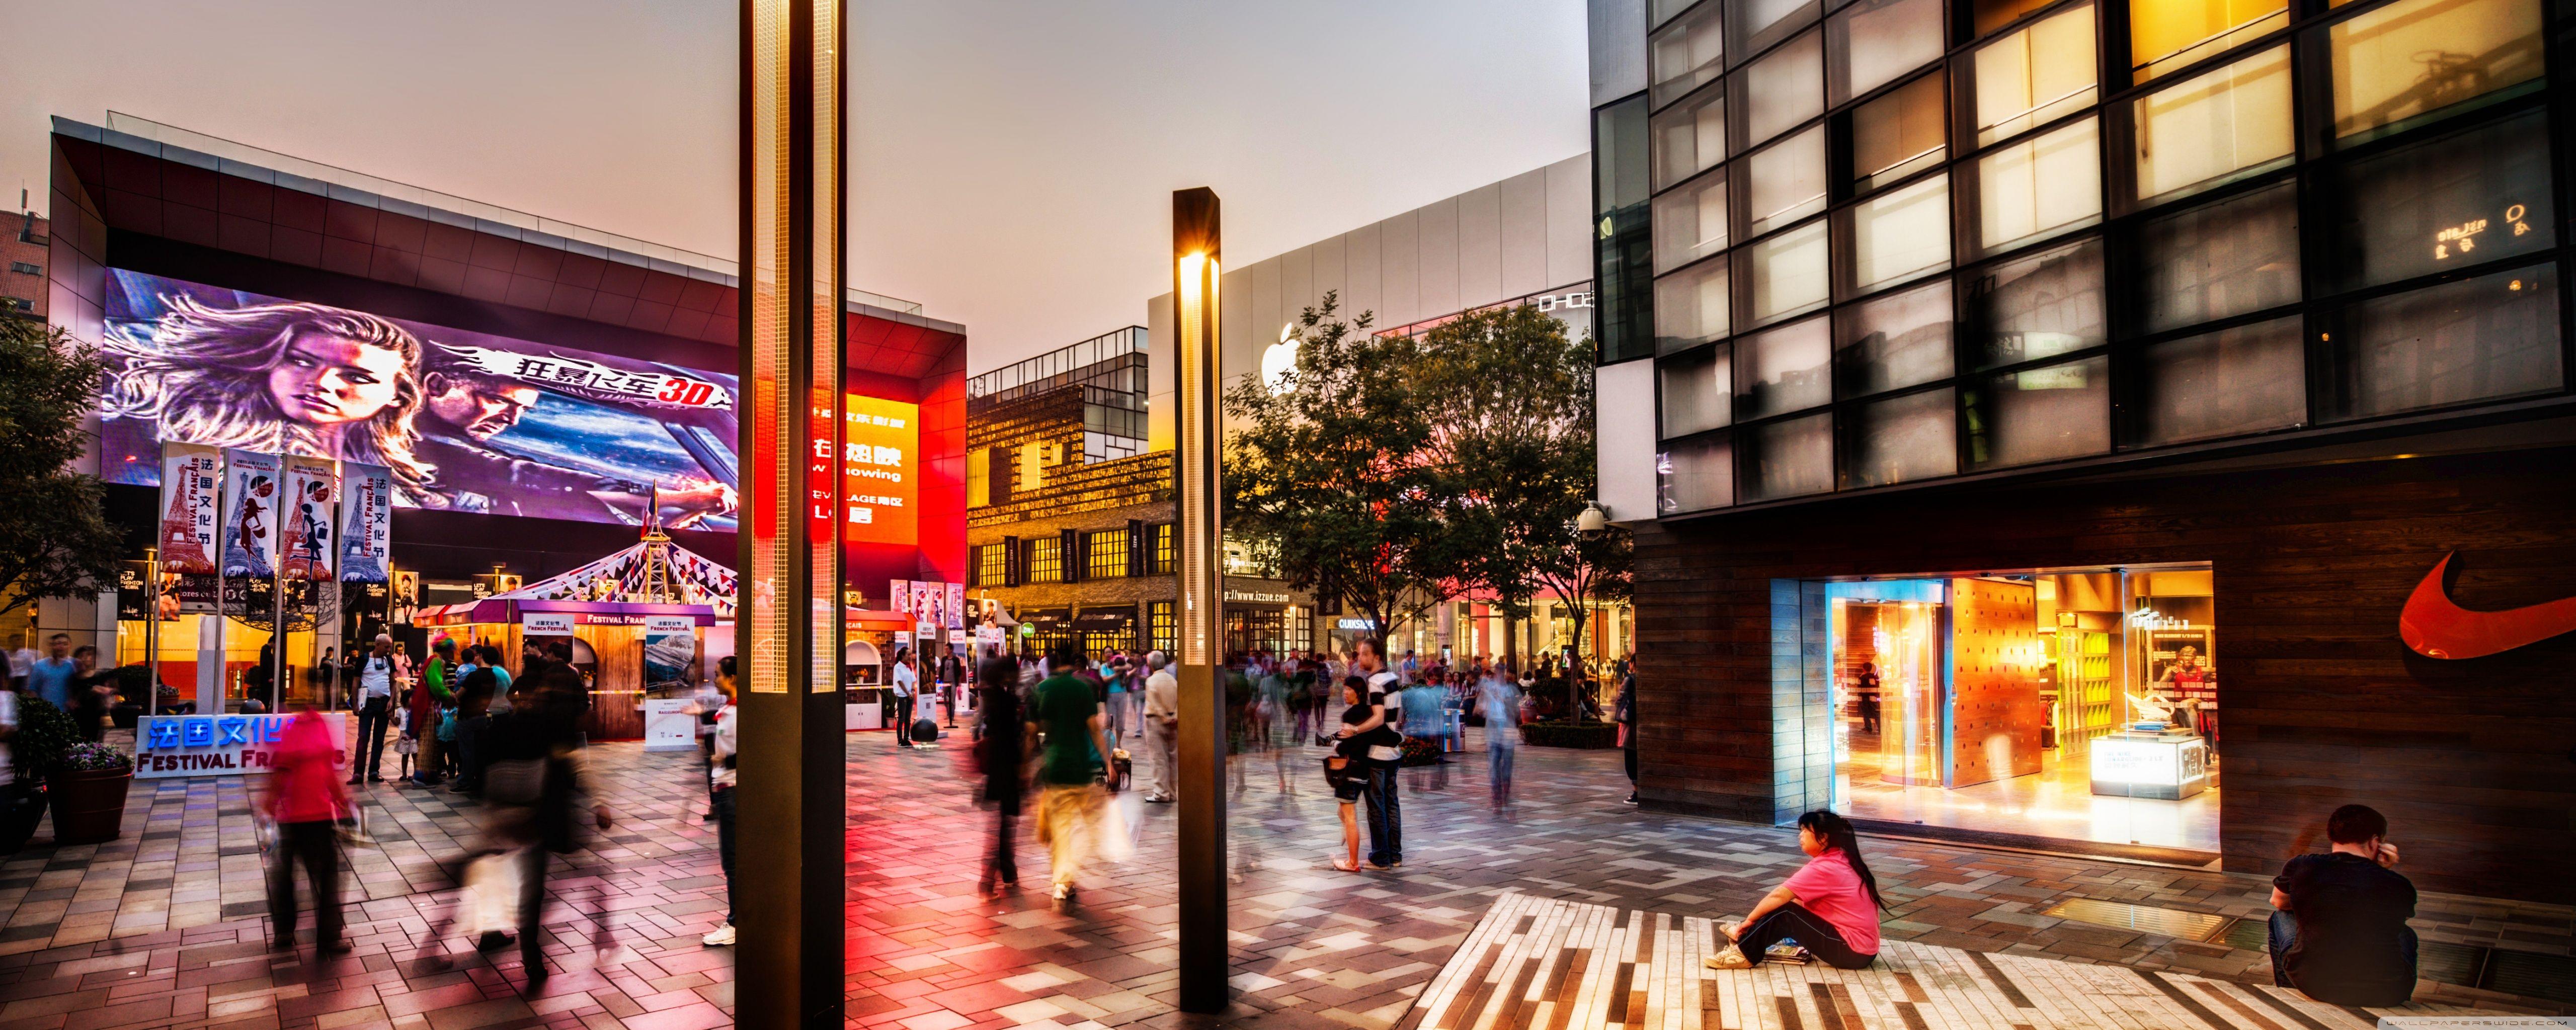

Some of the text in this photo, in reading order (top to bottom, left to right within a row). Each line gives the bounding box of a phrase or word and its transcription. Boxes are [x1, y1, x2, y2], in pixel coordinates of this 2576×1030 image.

[198, 458, 213, 545] 法国文化节
[374, 479, 386, 557] 法国文化节
[187, 503, 197, 544] FESTIVAL
[363, 521, 372, 557] FESTIVAL
[1224, 589, 1289, 602] p://www.izzue.com
[587, 615, 622, 624] FESTIVAL
[148, 717, 296, 749] 法国文化
[137, 753, 236, 772] FESTIVAL
